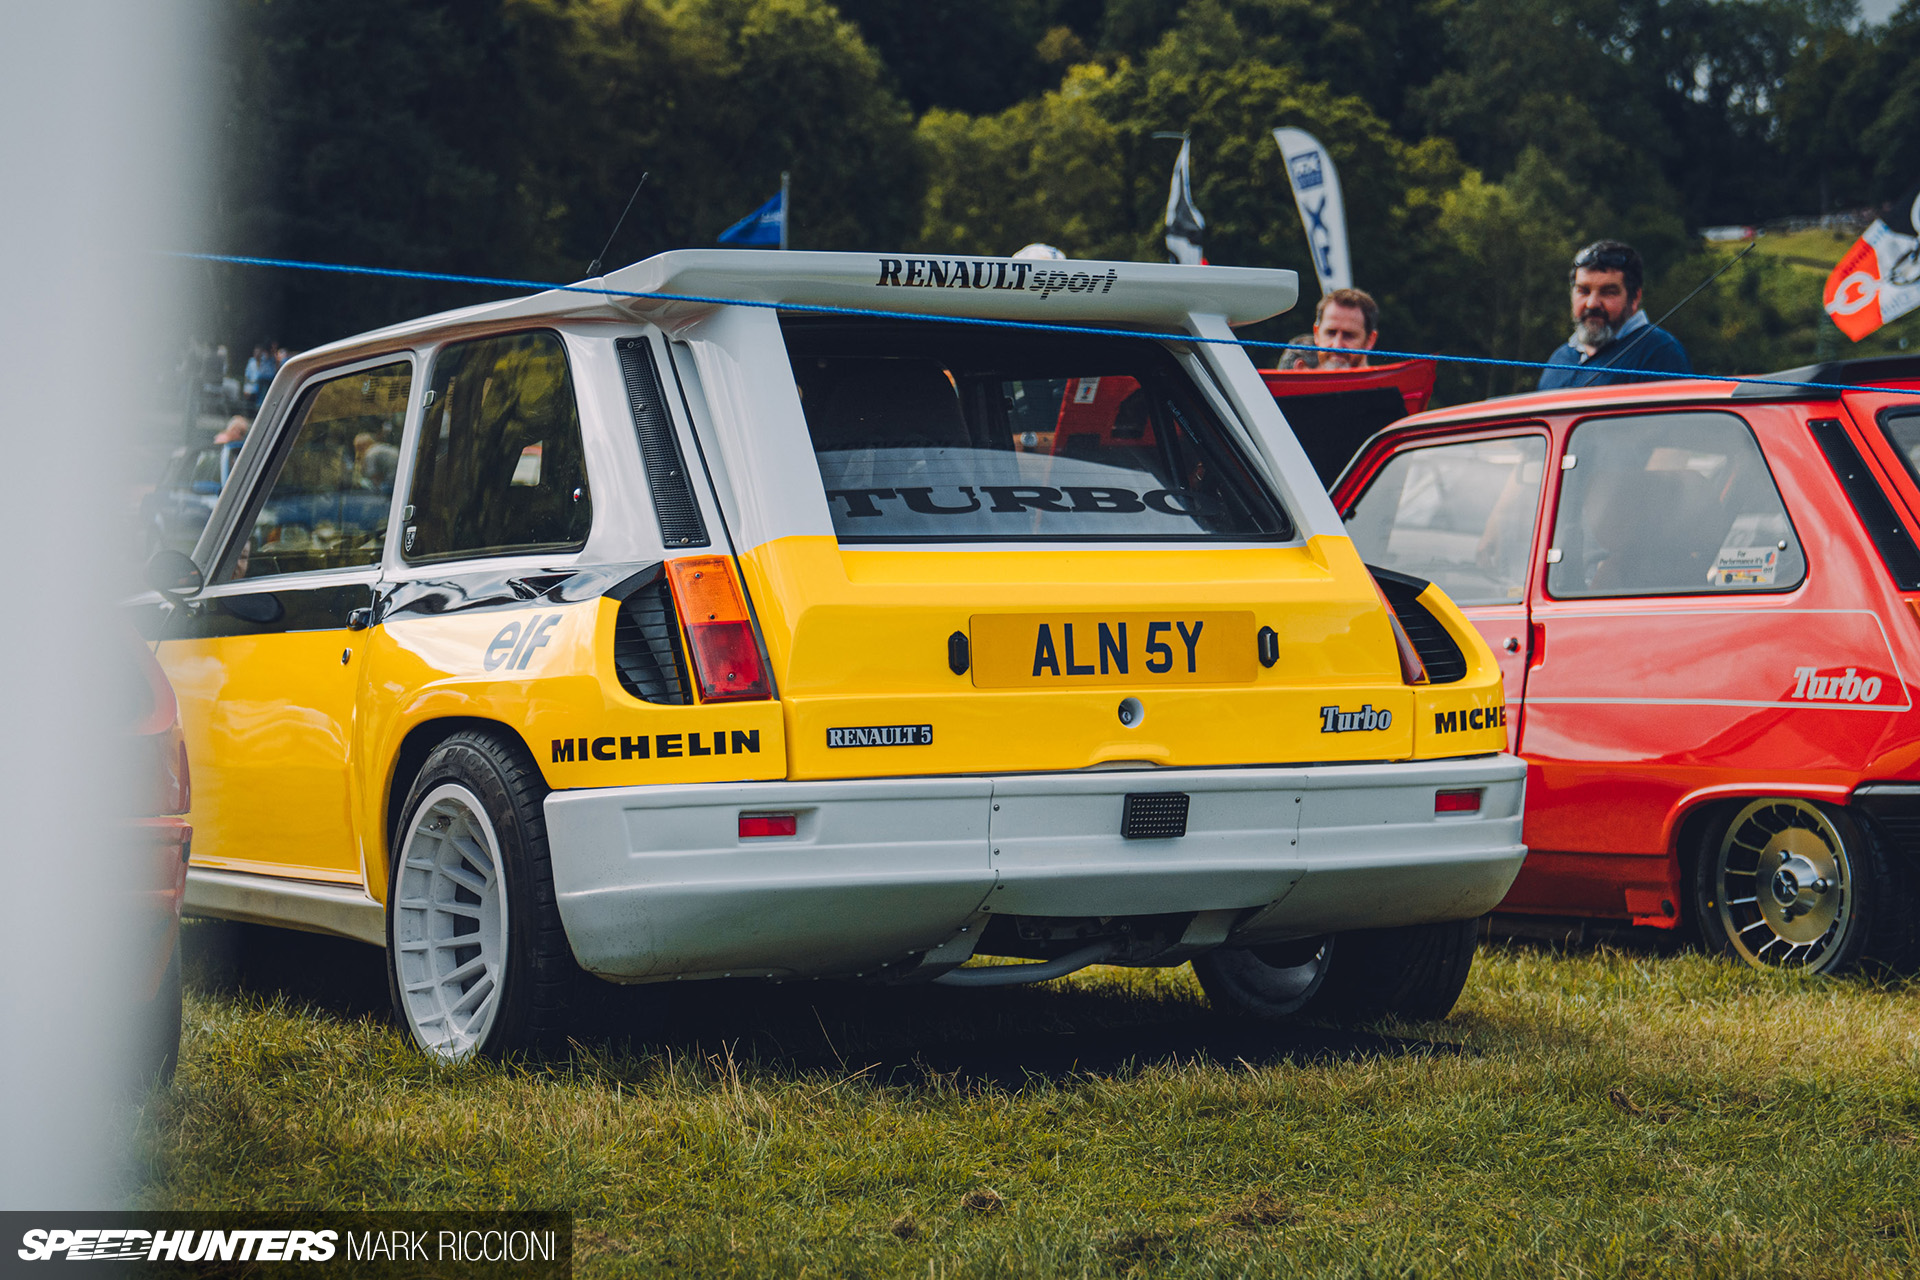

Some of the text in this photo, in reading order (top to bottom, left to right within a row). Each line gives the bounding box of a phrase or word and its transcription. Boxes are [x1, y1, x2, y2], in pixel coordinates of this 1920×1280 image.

[483, 614, 563, 672] elf
[1032, 620, 1204, 677] ALN 5Y
[1791, 666, 1882, 702] Turbo
[829, 725, 932, 748] RENAULT 5
[1320, 705, 1393, 733] Turbo
[551, 729, 760, 763] MICHELIN
